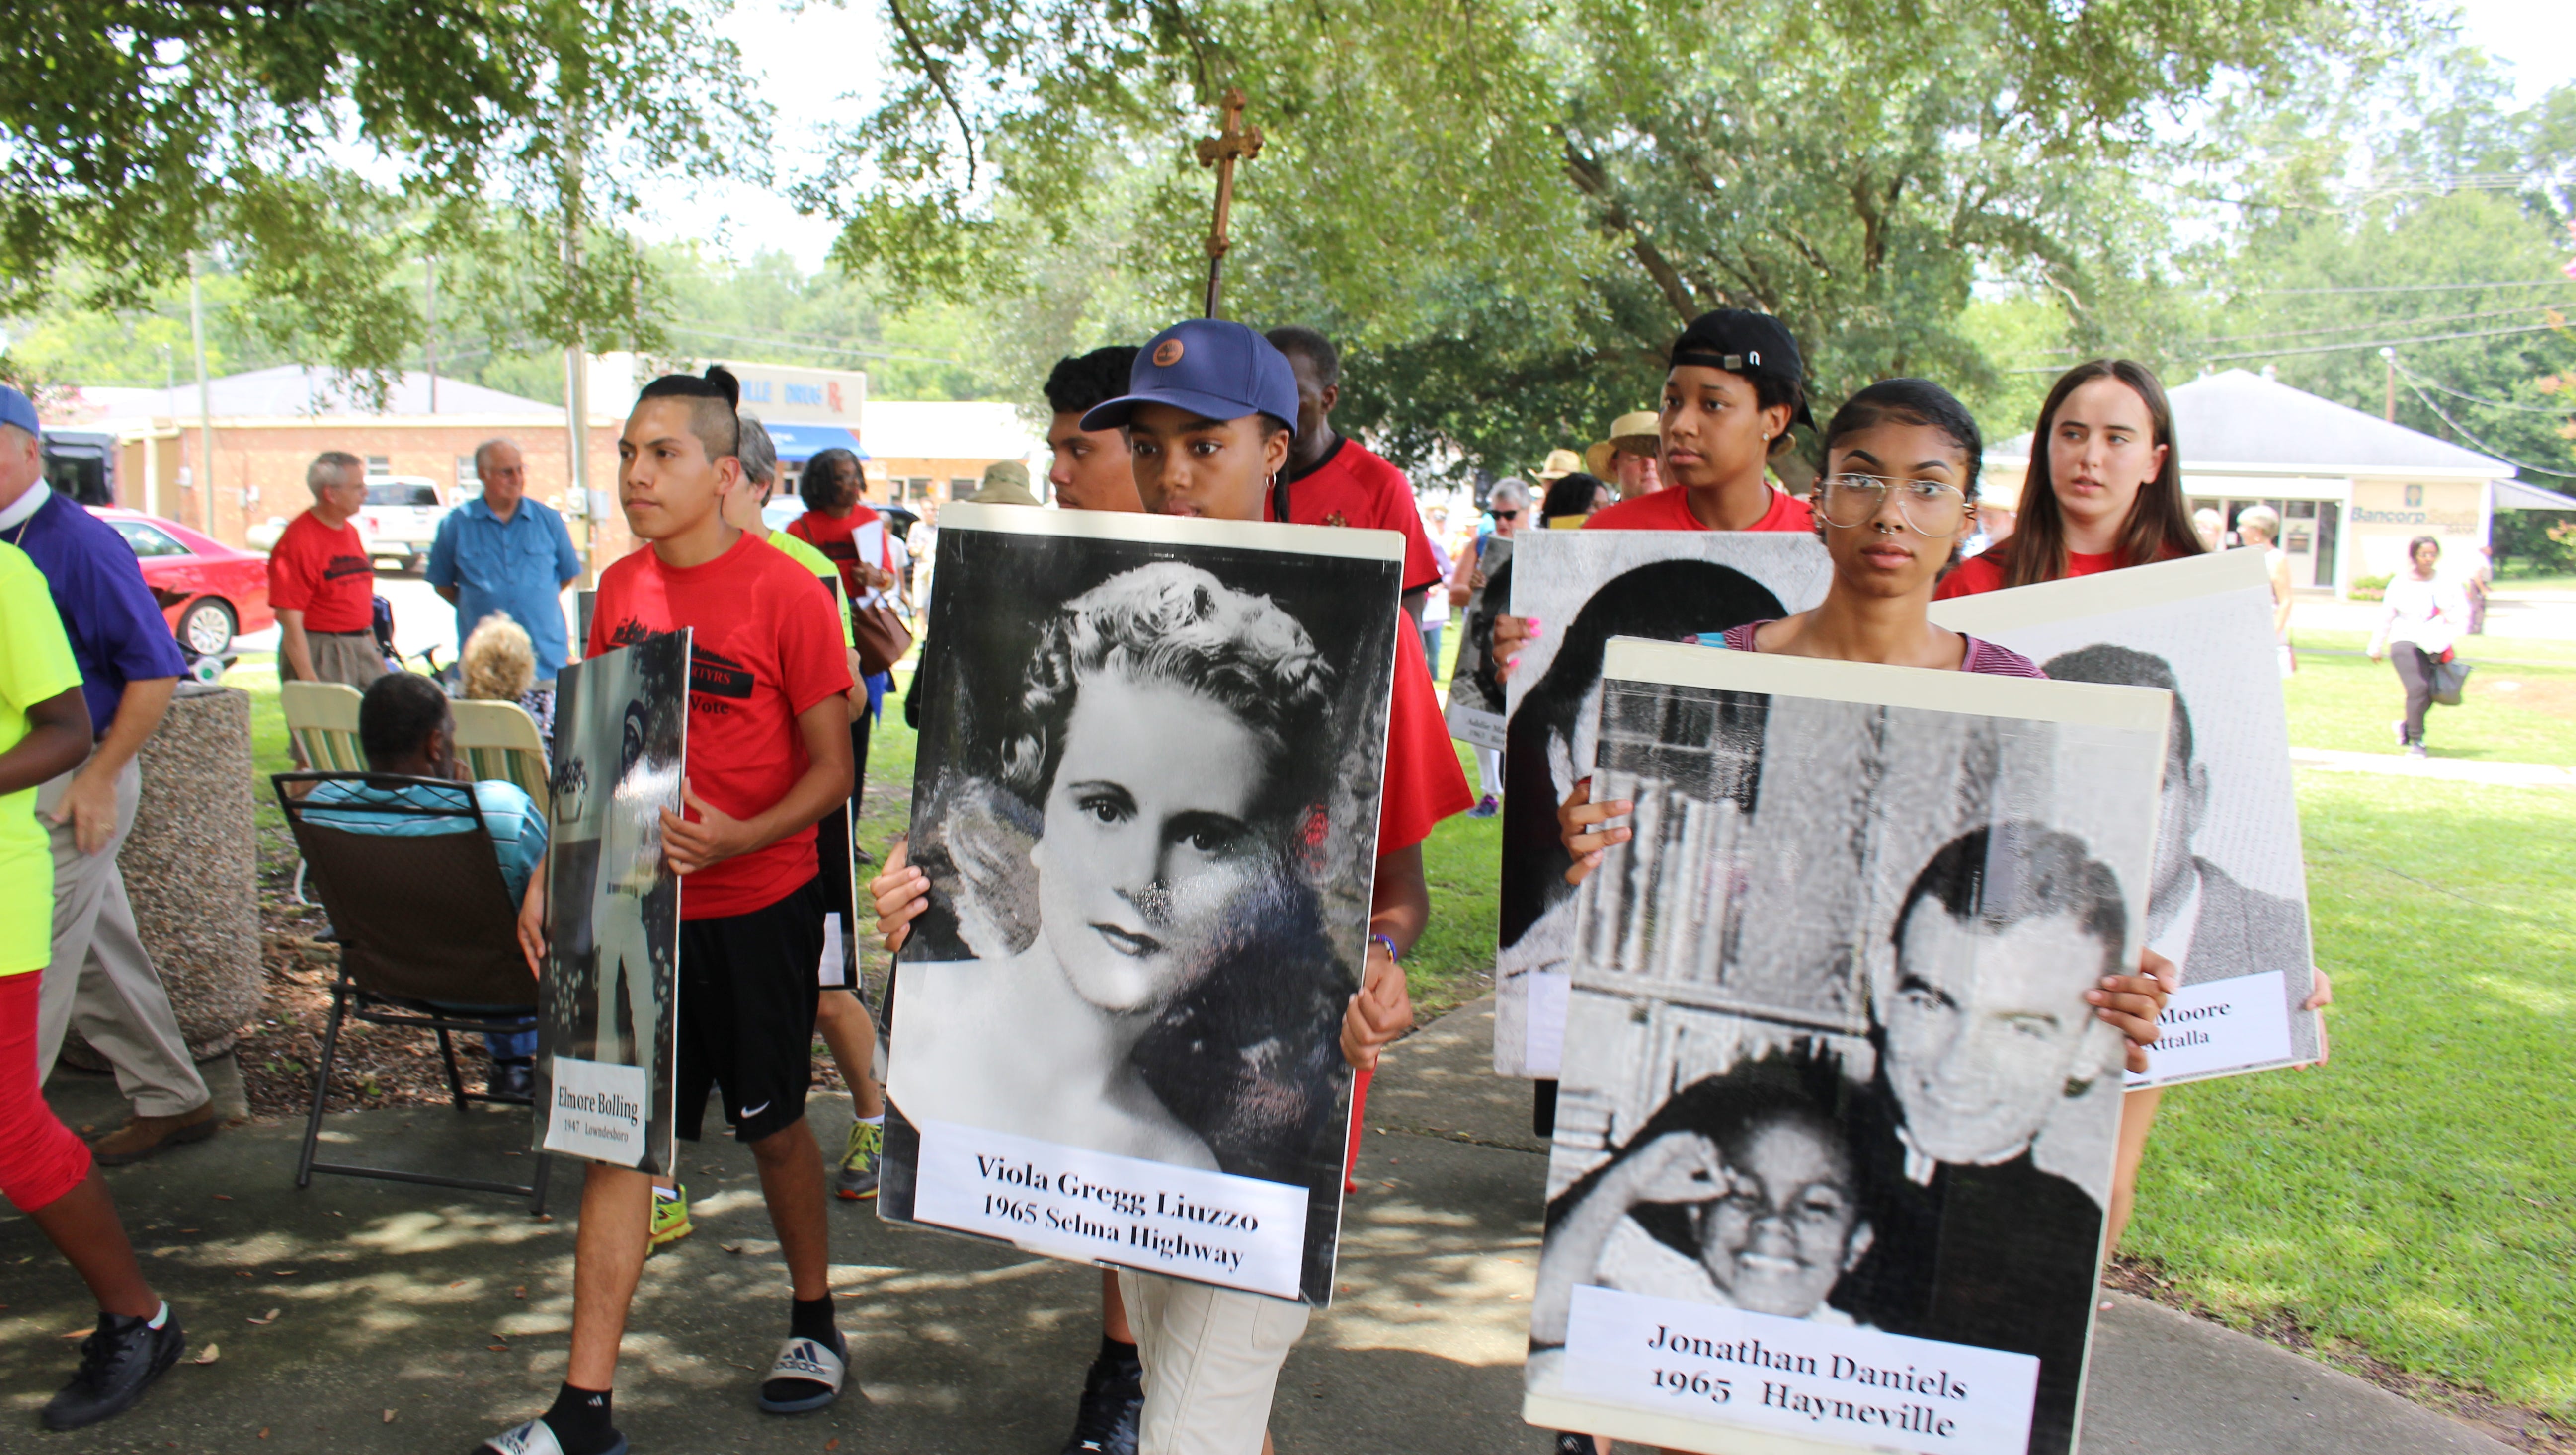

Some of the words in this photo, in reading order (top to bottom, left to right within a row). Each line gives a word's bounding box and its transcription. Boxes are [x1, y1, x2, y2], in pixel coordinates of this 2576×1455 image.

[741, 380, 771, 402] ILLE
[785, 383, 822, 405] DRUG
[691, 665, 731, 685] RTYRS
[2155, 1003, 2232, 1026] Moore
[558, 1085, 595, 1114] Elmore
[598, 1092, 638, 1126] Bolling
[564, 1119, 580, 1133] 1947
[585, 1123, 629, 1143] Lowndesboro
[976, 1152, 1049, 1192] Viola
[1057, 1171, 1147, 1217] Gregg
[1156, 1191, 1259, 1233] Liuzzo
[983, 1193, 1038, 1225] 1965
[1045, 1207, 1121, 1242] Selma
[1129, 1224, 1245, 1273] Highway
[1647, 1323, 1818, 1376] Jonathan
[1829, 1353, 1969, 1401] Daniels
[1651, 1367, 1732, 1405] 1965
[1760, 1380, 1957, 1439] Hayneville
